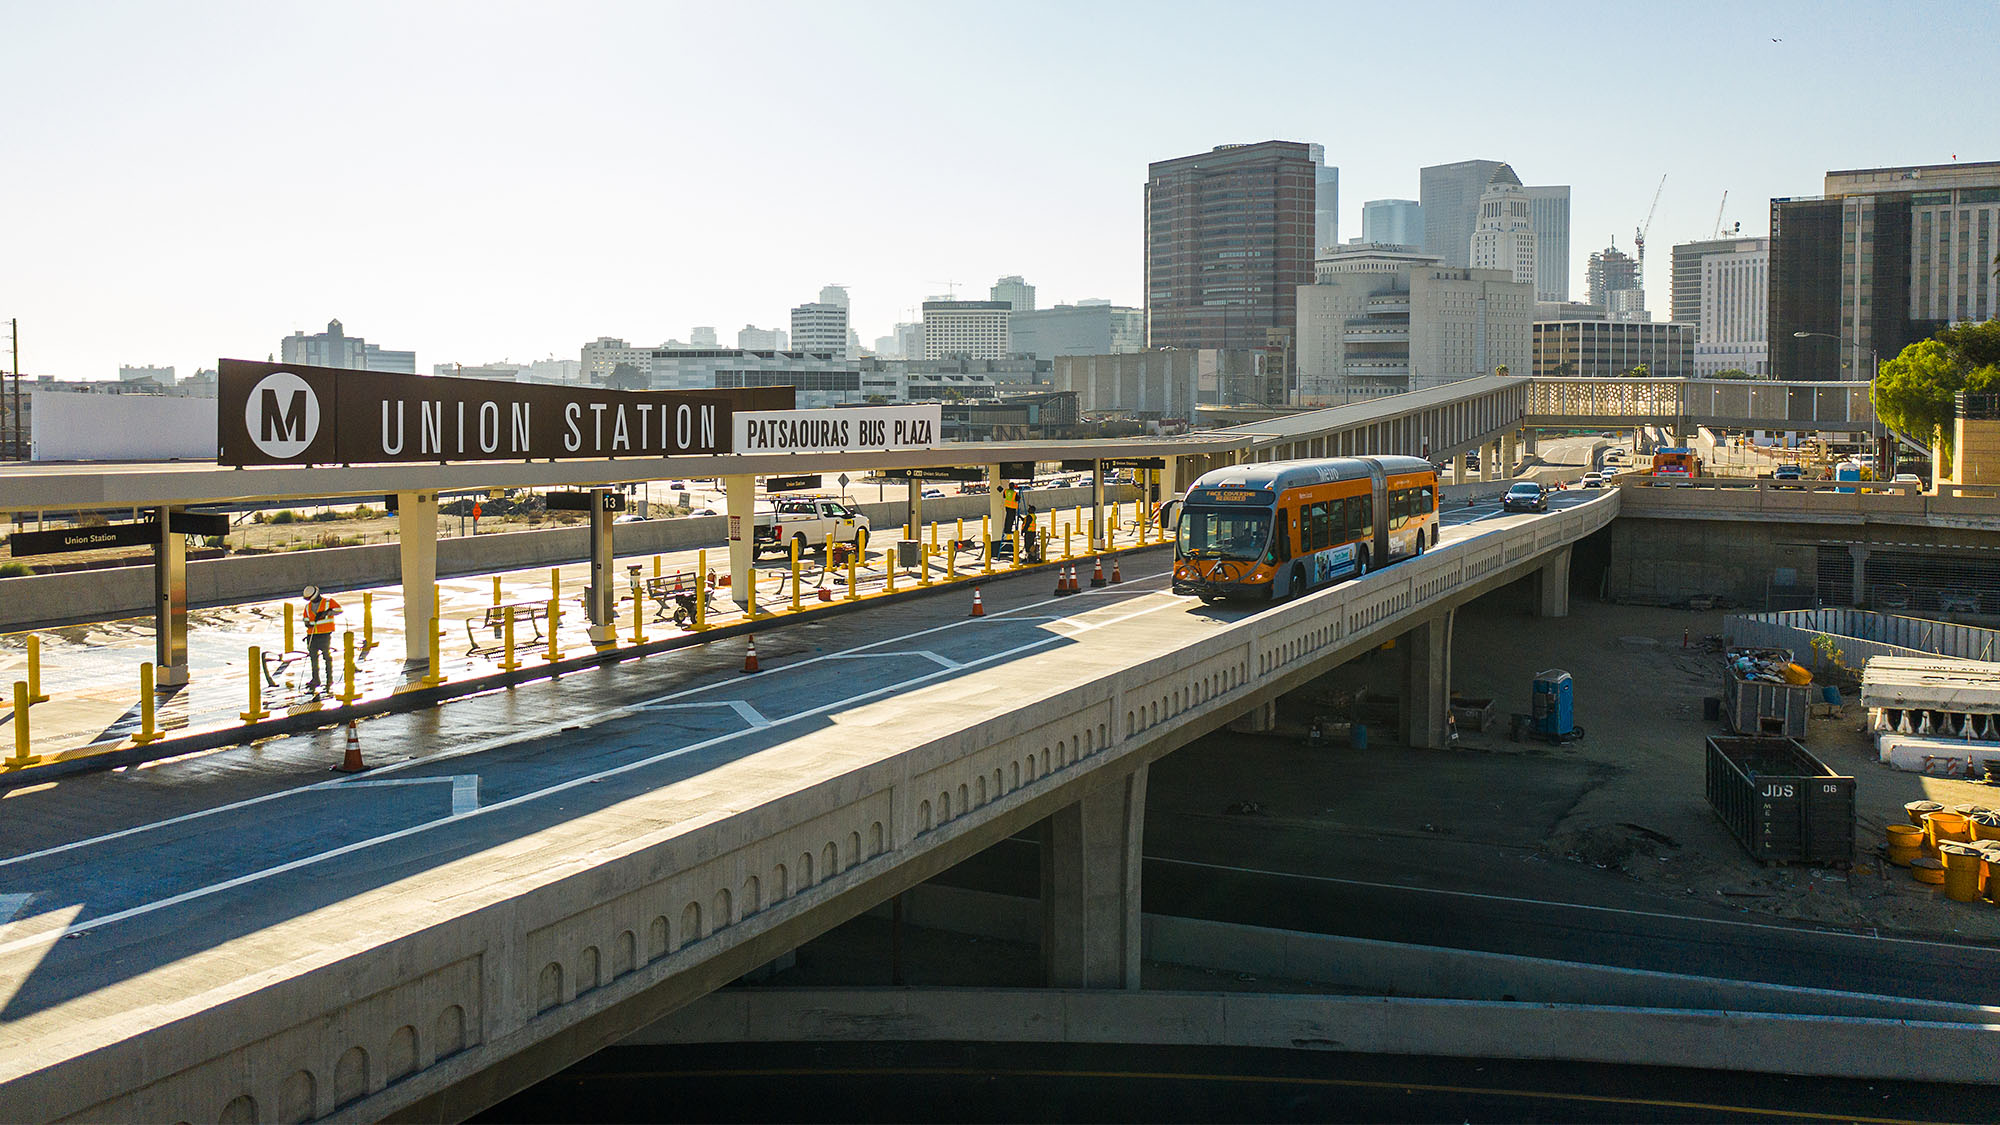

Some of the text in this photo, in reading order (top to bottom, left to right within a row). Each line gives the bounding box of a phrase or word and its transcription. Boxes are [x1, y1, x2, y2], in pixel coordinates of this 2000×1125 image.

[260, 388, 307, 442] M
[382, 400, 716, 455] UNION STATION
[747, 419, 933, 449] PATSAOURAS BUS PLAZA
[1101, 462, 1110, 470] 11
[1314, 465, 1339, 481] Metro
[603, 497, 617, 509] 13
[64, 533, 117, 546] Union Station
[1761, 784, 1794, 798] JDS
[1823, 784, 1837, 793] 06
